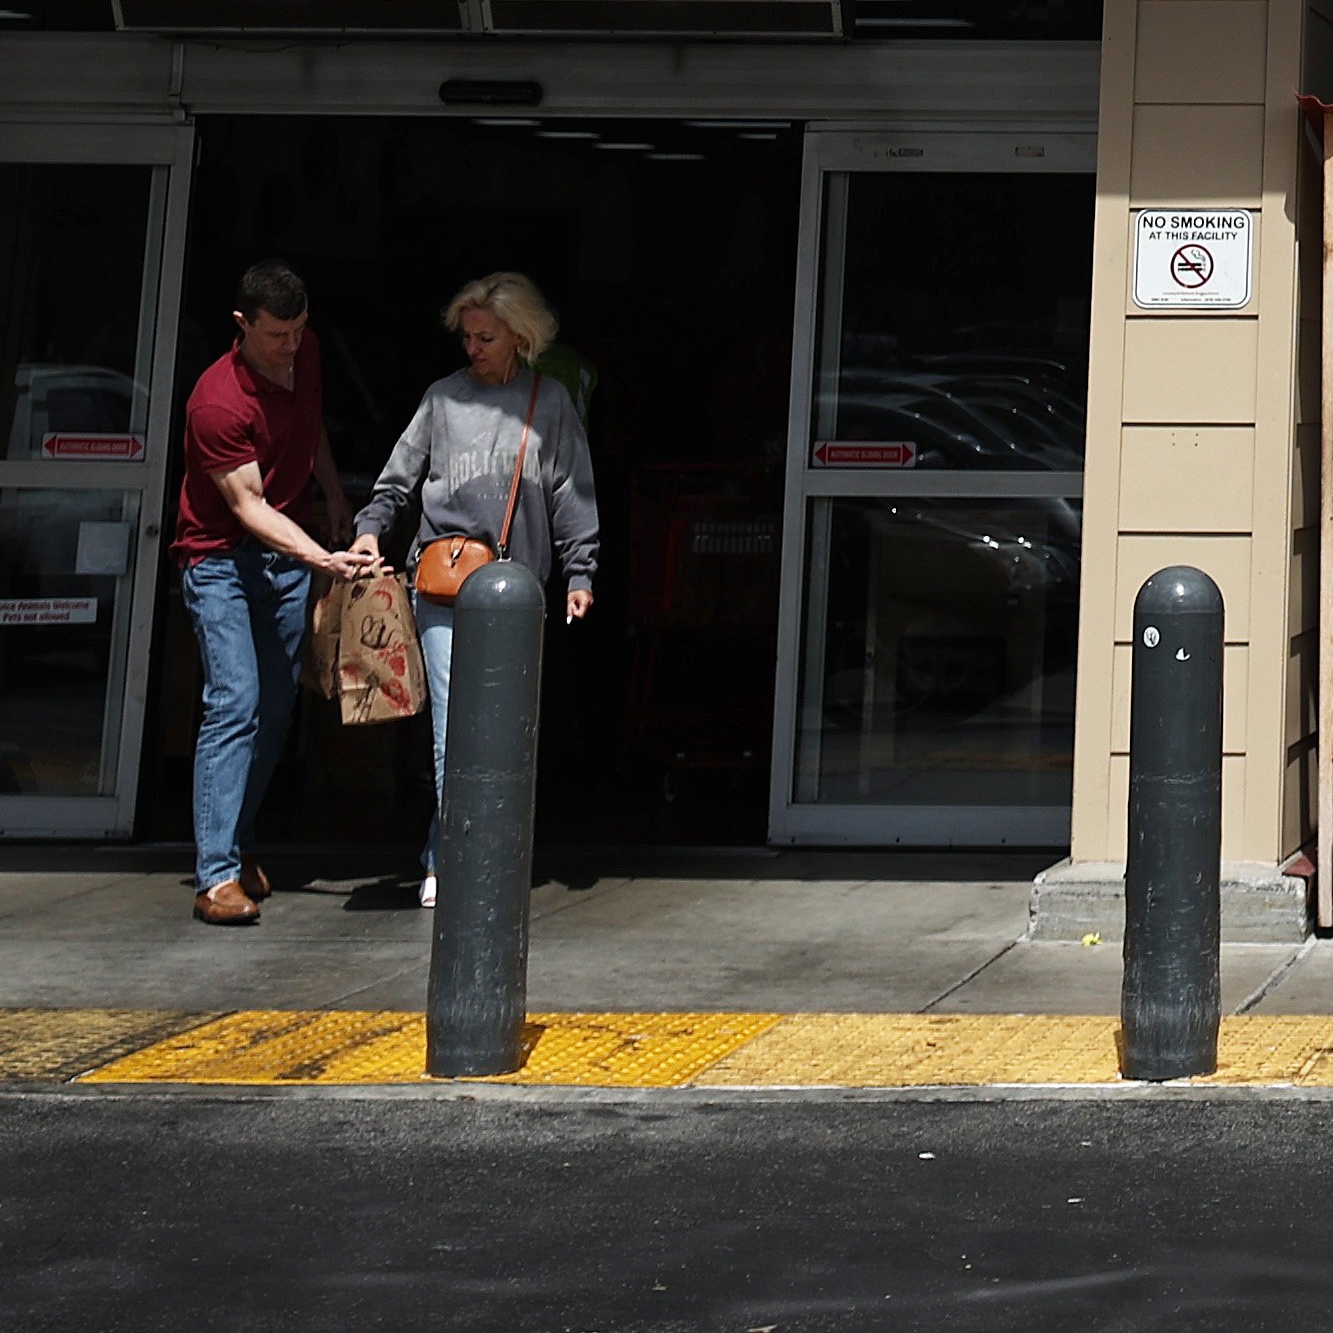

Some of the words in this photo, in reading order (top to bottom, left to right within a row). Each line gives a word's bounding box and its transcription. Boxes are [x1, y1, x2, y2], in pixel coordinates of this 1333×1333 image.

[1143, 216, 1166, 229] NO
[1170, 216, 1245, 229] SMOKING
[1148, 231, 1162, 240] AT
[1165, 231, 1189, 240] THIS
[1191, 231, 1238, 241] FACILITY
